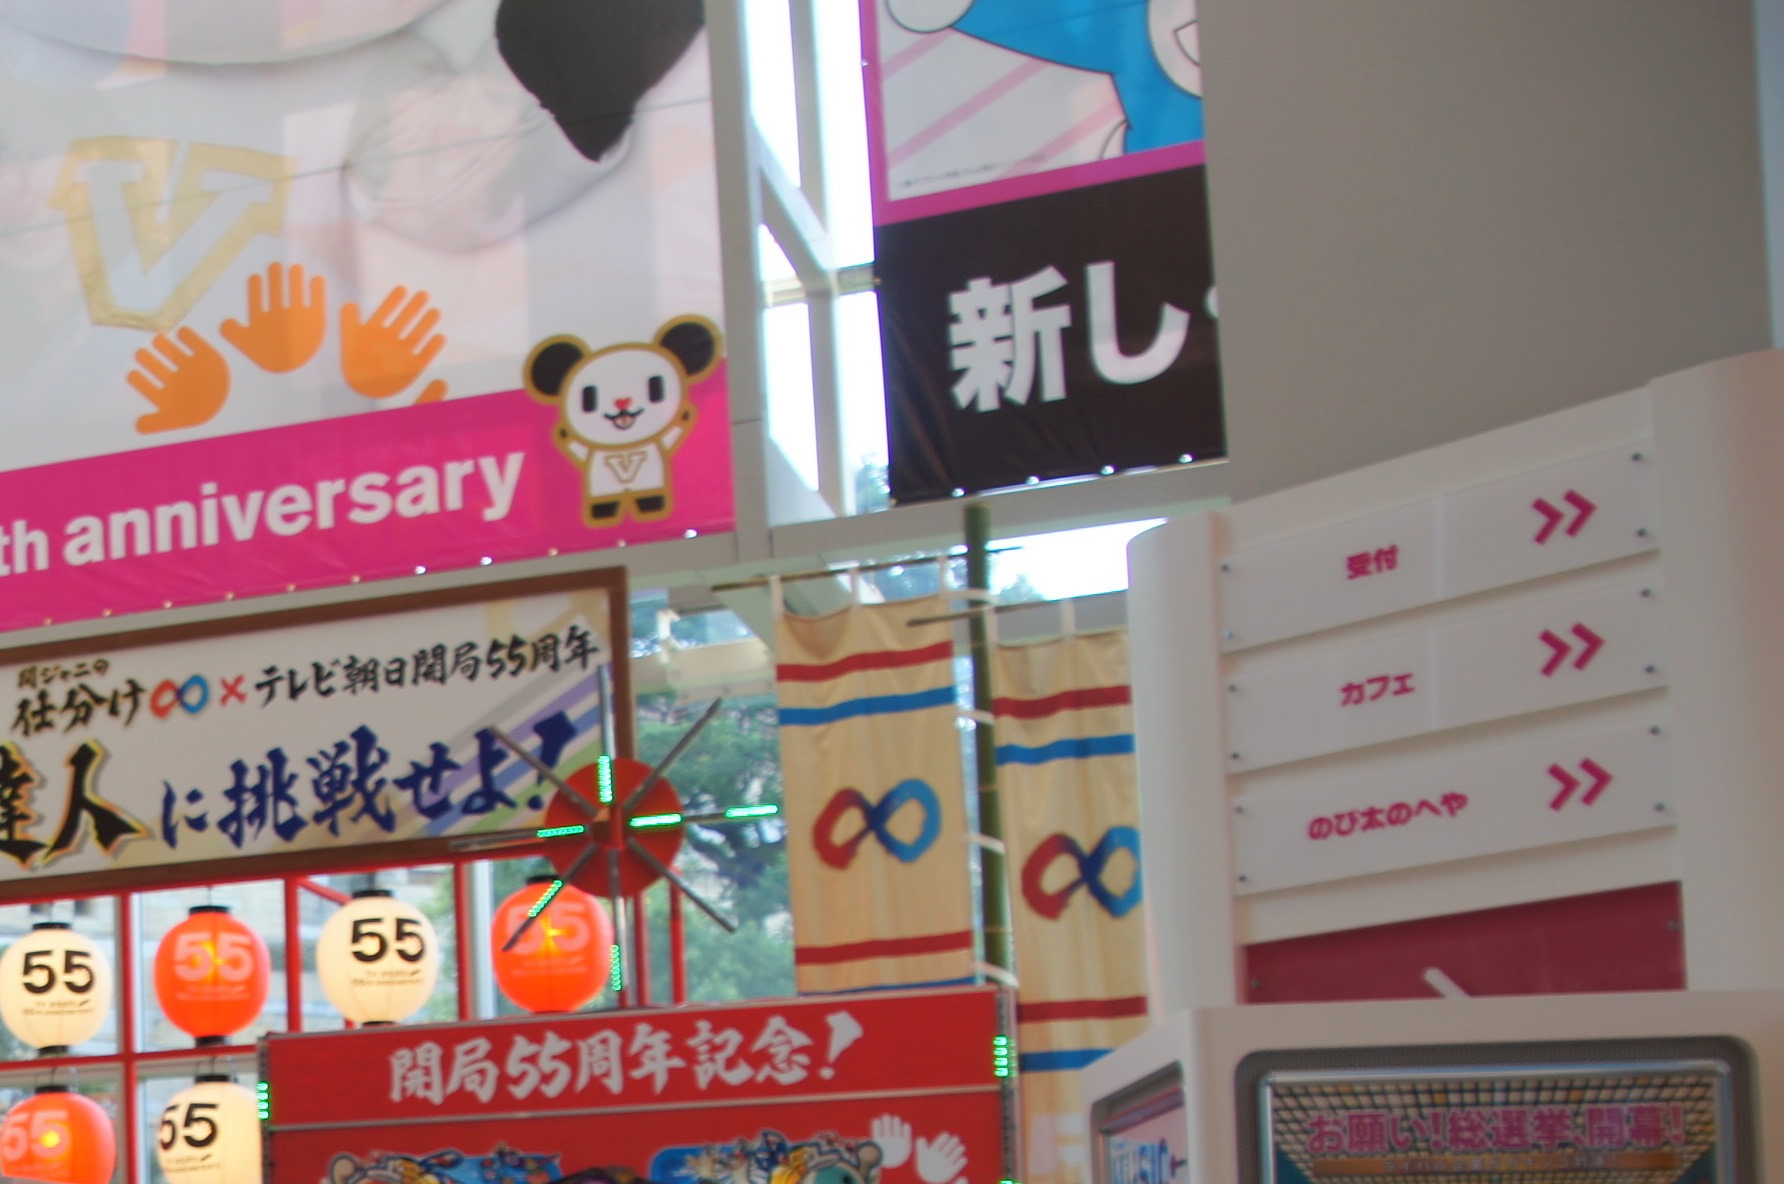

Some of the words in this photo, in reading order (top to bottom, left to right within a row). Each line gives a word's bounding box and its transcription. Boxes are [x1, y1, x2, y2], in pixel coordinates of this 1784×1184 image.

[947, 260, 1220, 413] 新し
[62, 451, 525, 567] anniversary
[1345, 544, 1400, 580] 受付
[1340, 671, 1415, 706] カフェ
[161, 710, 578, 850] に挑戦せよ!
[1308, 792, 1469, 841] のび太のへや
[173, 931, 253, 983] 55
[350, 917, 426, 963] 55
[22, 949, 95, 994] 55
[387, 1012, 864, 1106] 開局55周年記念!
[158, 1103, 219, 1149] 55
[1307, 1104, 1686, 1156] お願い!総選挙、開幕!
